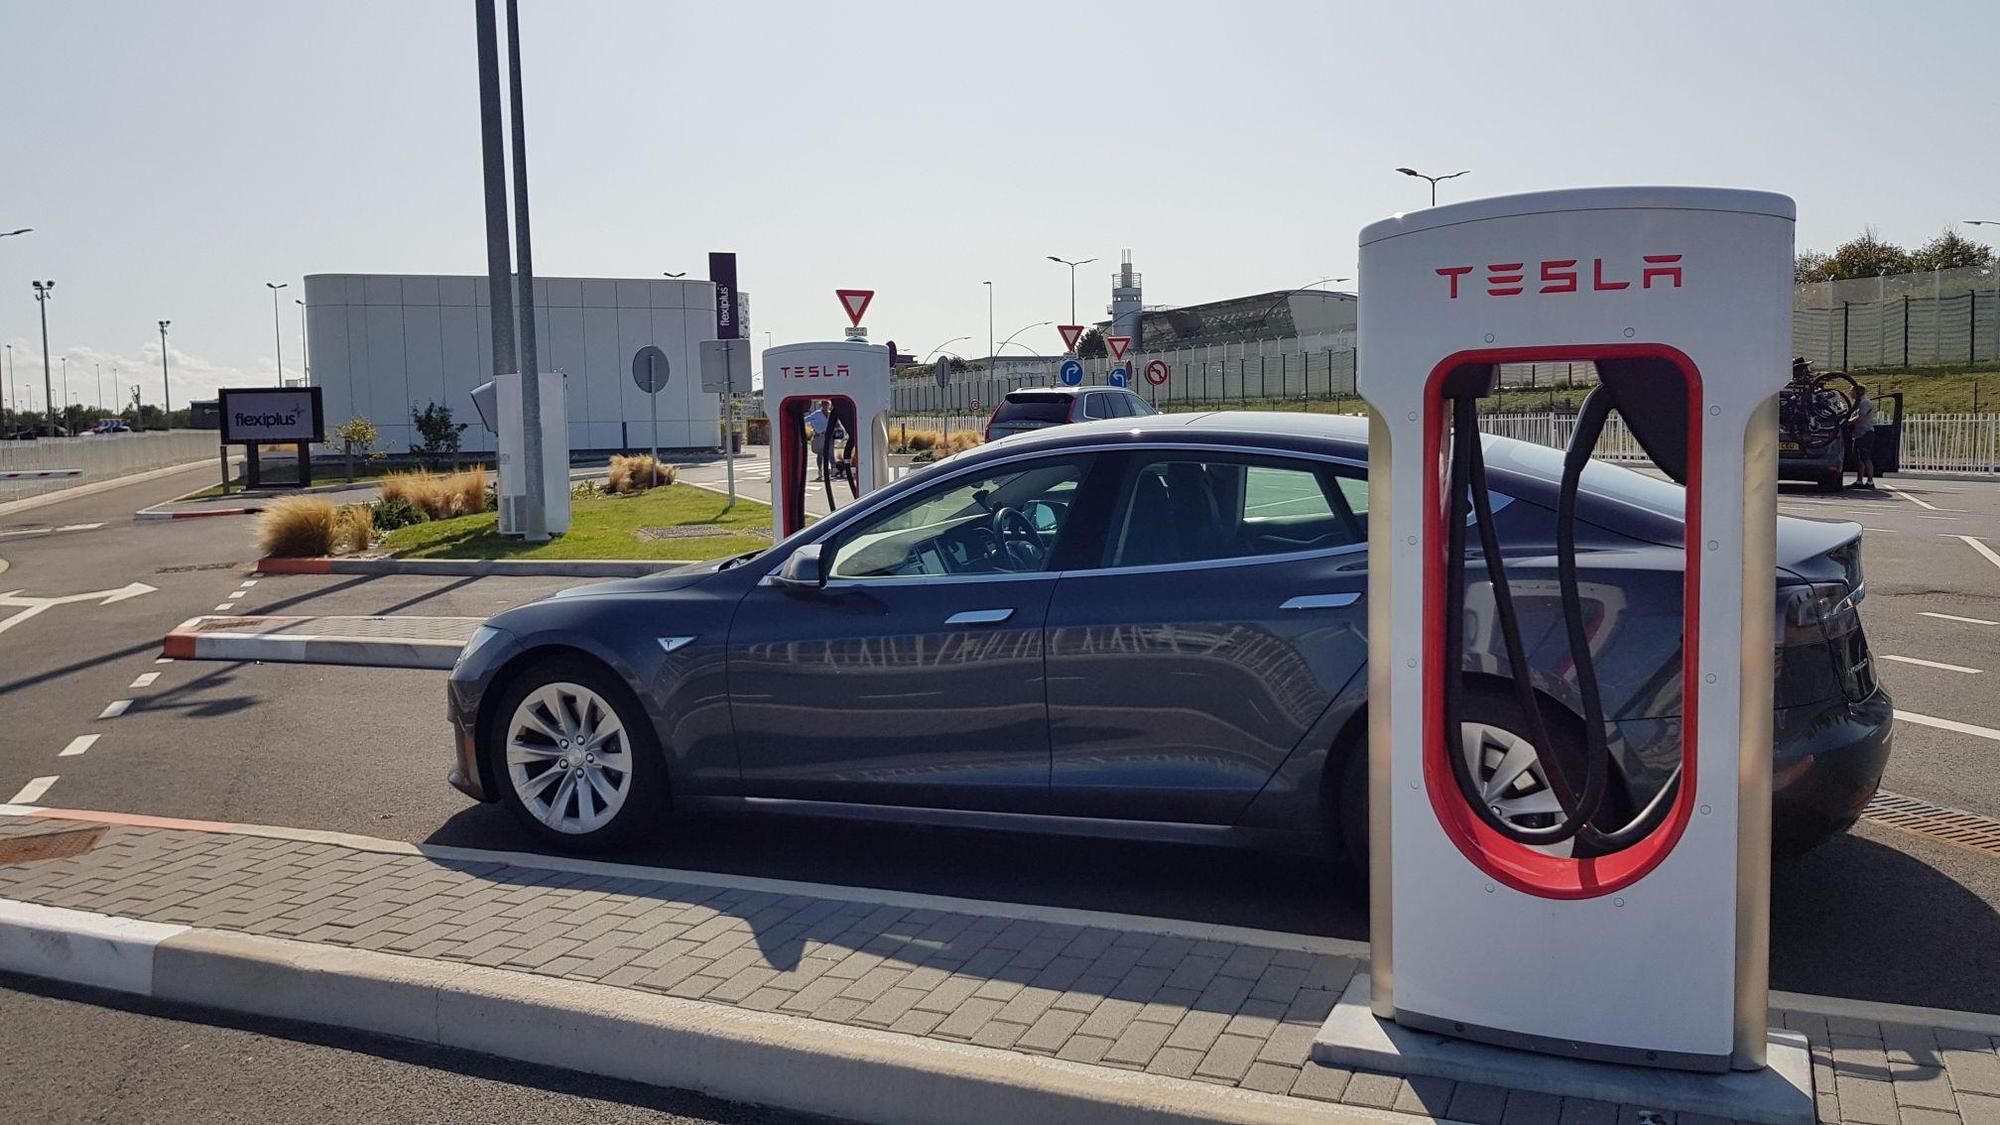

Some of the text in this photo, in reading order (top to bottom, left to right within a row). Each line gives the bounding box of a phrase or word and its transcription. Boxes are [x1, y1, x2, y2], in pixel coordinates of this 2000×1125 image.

[1434, 254, 1683, 299] TESLA
[720, 286, 731, 327] flexiplus
[780, 364, 849, 379] TESLA
[235, 412, 297, 429] flexiplus
